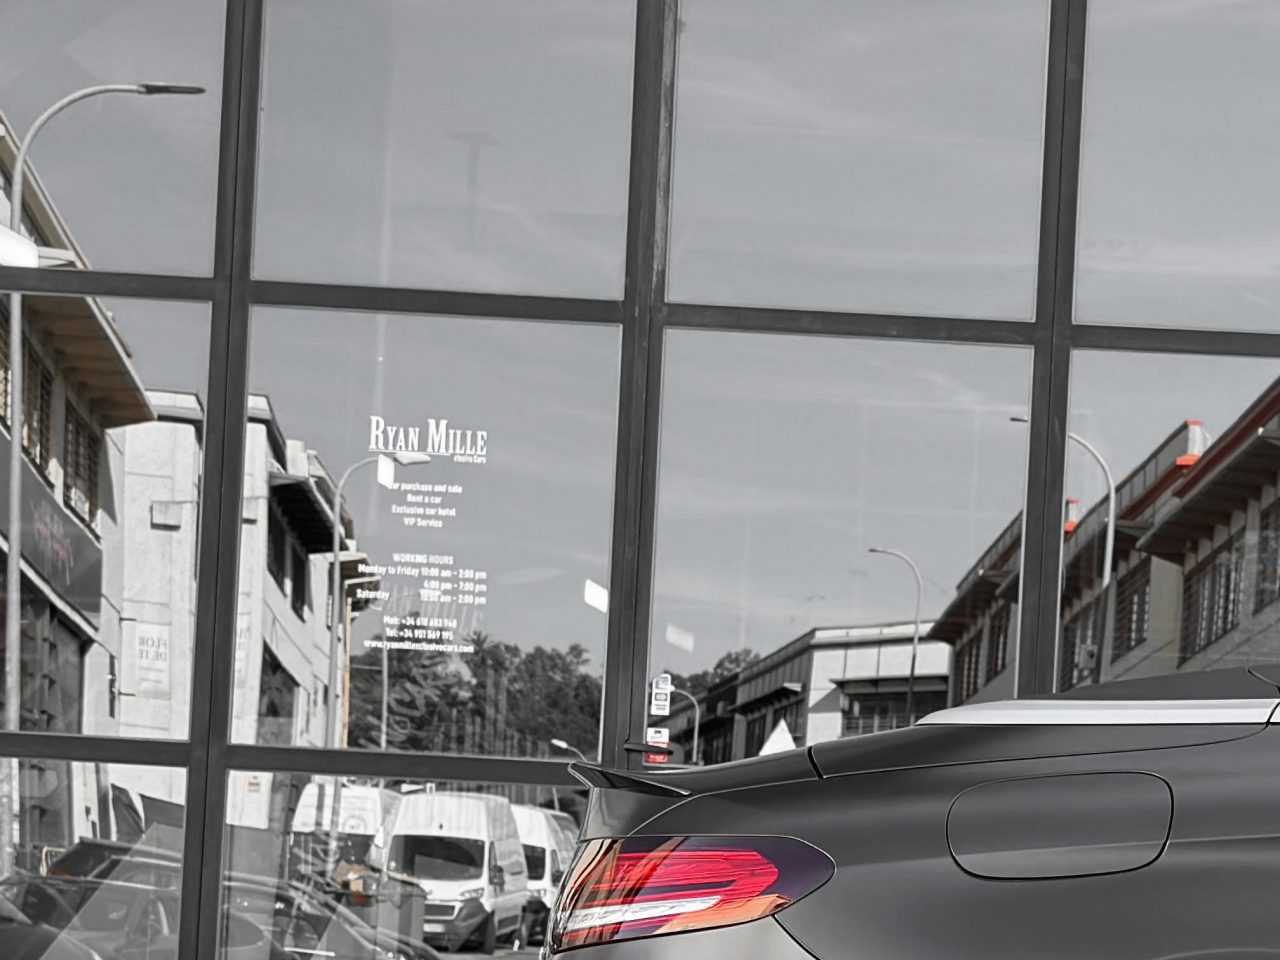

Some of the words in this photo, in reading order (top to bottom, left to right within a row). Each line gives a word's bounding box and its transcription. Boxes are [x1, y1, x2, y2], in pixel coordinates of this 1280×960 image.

[369, 415, 420, 451] RYAN
[426, 418, 488, 455] MILLE
[401, 482, 432, 492] purchase
[434, 483, 447, 492] and
[448, 484, 463, 493] sale
[407, 494, 424, 503] Rent
[430, 496, 442, 504] car
[391, 505, 424, 515] Exclusive
[425, 507, 437, 516] car
[403, 517, 416, 526] VIP
[417, 518, 443, 528] Service
[392, 553, 428, 564] WORKING
[429, 555, 454, 565] HOURS
[358, 564, 387, 576] Monday
[388, 566, 396, 574] to
[396, 566, 420, 577] Friday
[440, 569, 452, 577] am
[475, 571, 487, 580] pm
[440, 582, 452, 591] pm
[475, 584, 487, 593] pm
[356, 588, 390, 600] Saturday
[440, 595, 452, 603] am
[474, 597, 487, 606] pm
